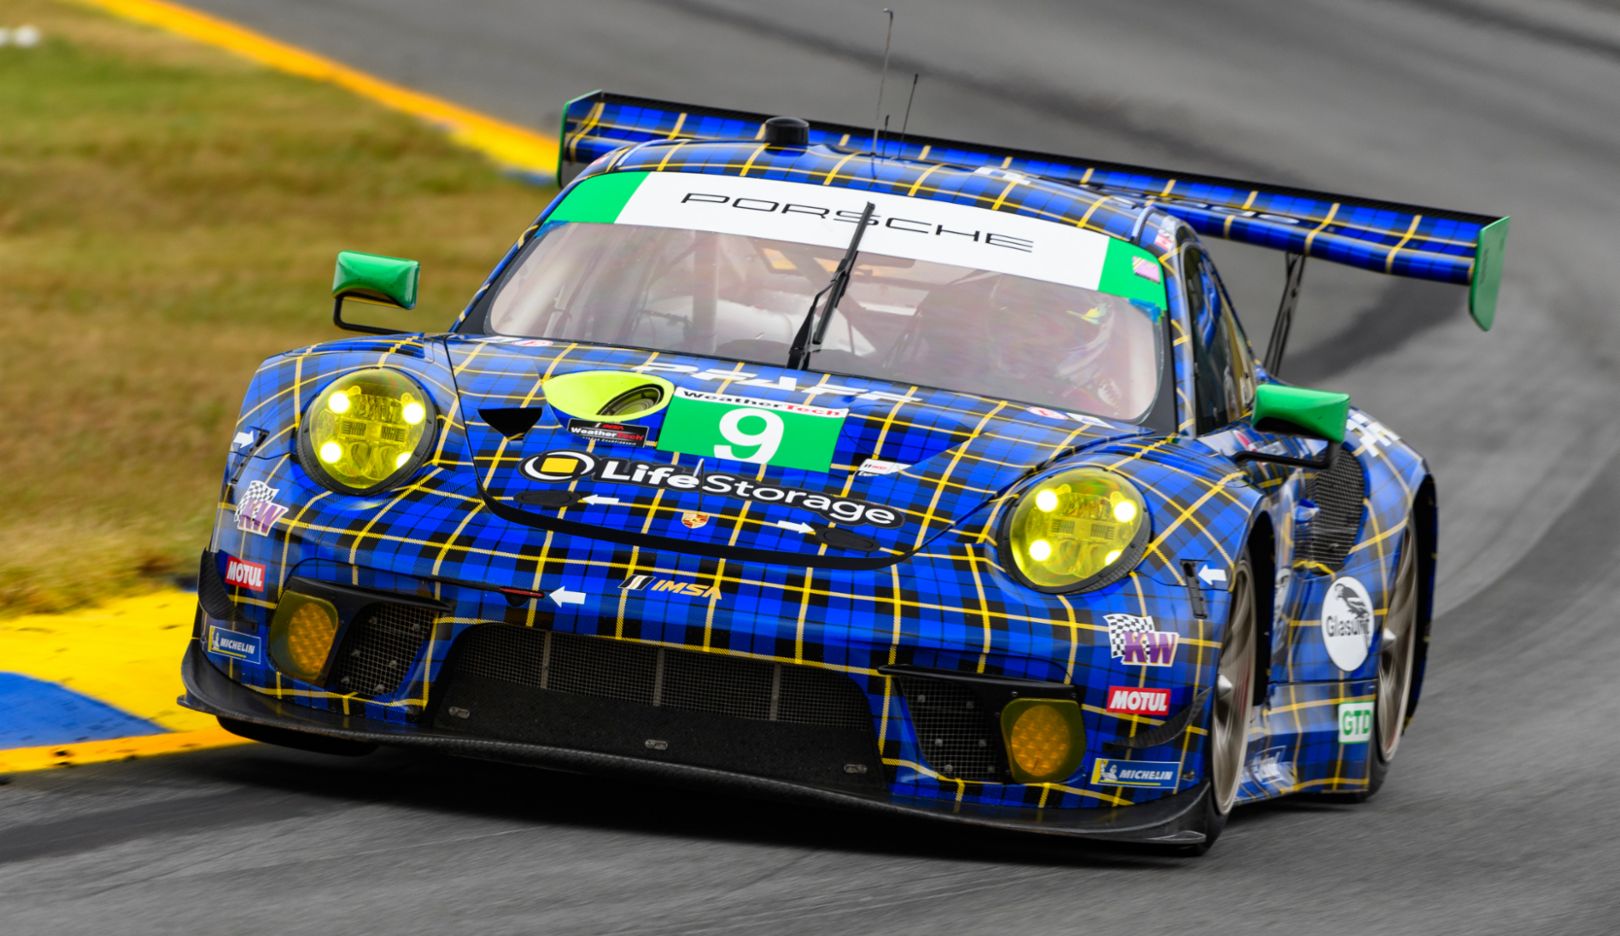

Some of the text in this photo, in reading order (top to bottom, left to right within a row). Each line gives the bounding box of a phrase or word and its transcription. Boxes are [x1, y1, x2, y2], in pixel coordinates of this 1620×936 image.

[681, 192, 1034, 253] PORSCHE
[684, 390, 840, 417] WeatherTech
[713, 408, 785, 464] 9
[226, 560, 263, 587] MOTUL
[651, 579, 722, 600] IMSA
[220, 636, 256, 654] MICHELIN
[1124, 631, 1178, 665] KW
[1109, 690, 1168, 712] MOTUL
[1343, 710, 1374, 735] GTD
[1119, 769, 1174, 780] MICHELIN
